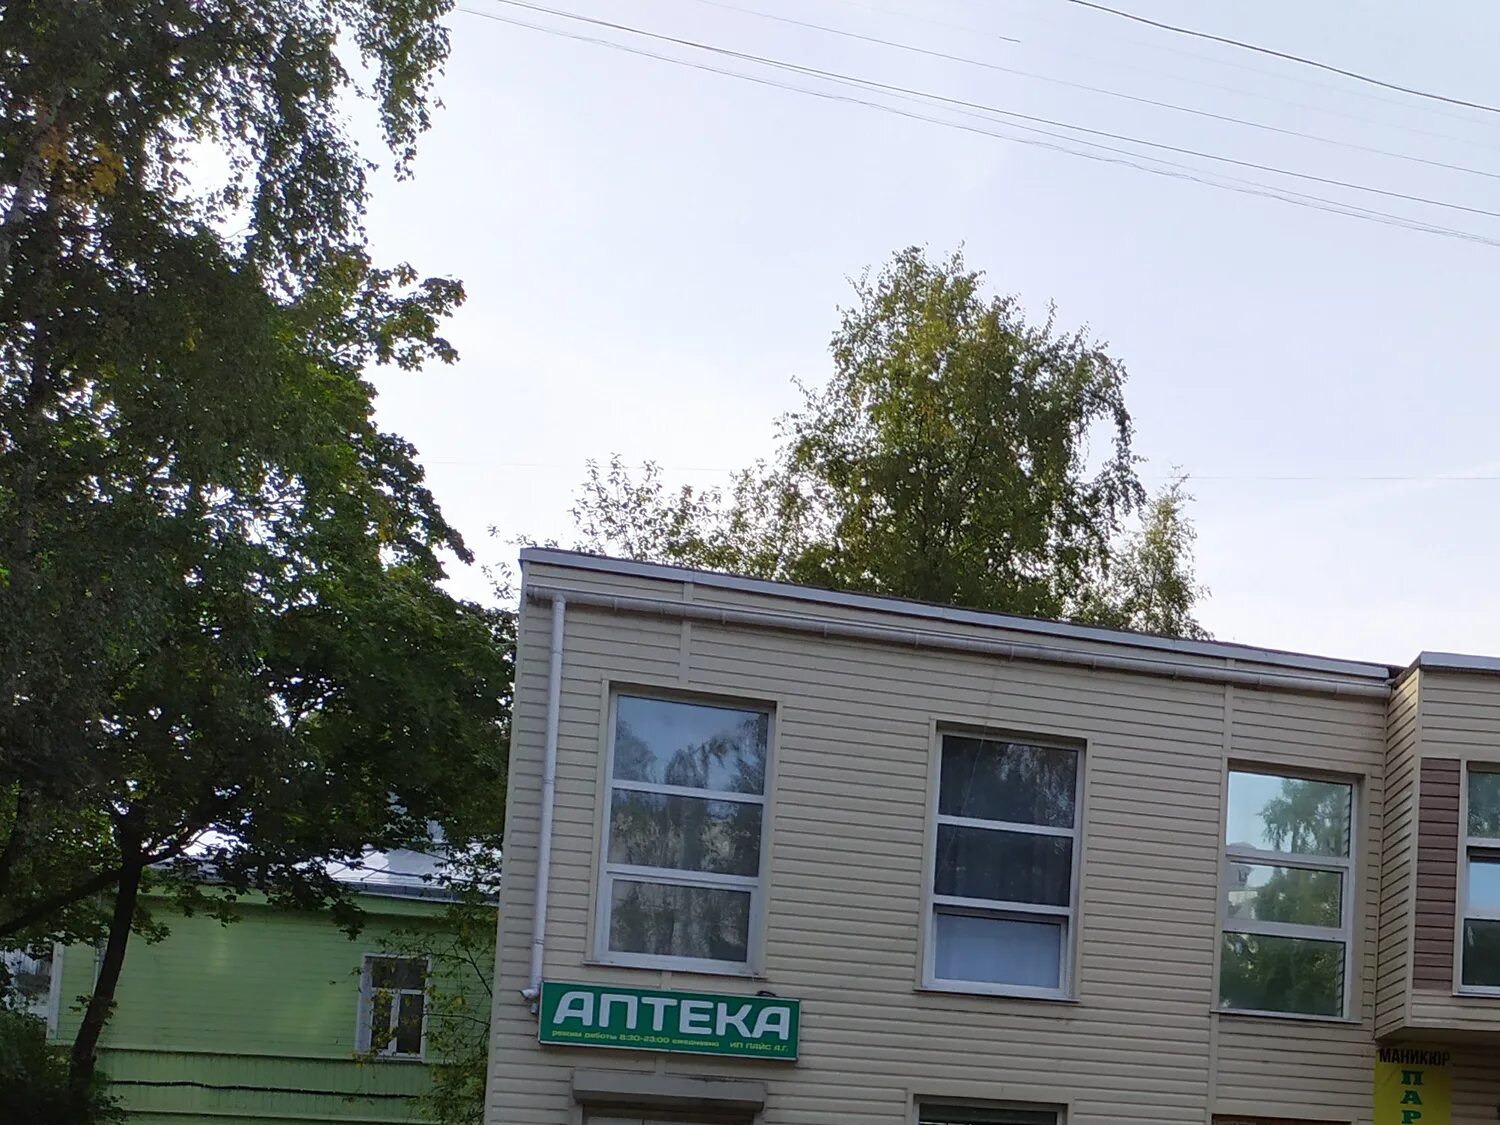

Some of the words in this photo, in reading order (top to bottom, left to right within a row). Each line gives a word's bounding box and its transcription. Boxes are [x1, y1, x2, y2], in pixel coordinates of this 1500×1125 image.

[553, 991, 790, 1040] АПТЕКА
[729, 1041, 743, 1049] ИП
[1379, 1048, 1450, 1066] МАНИКЮР
